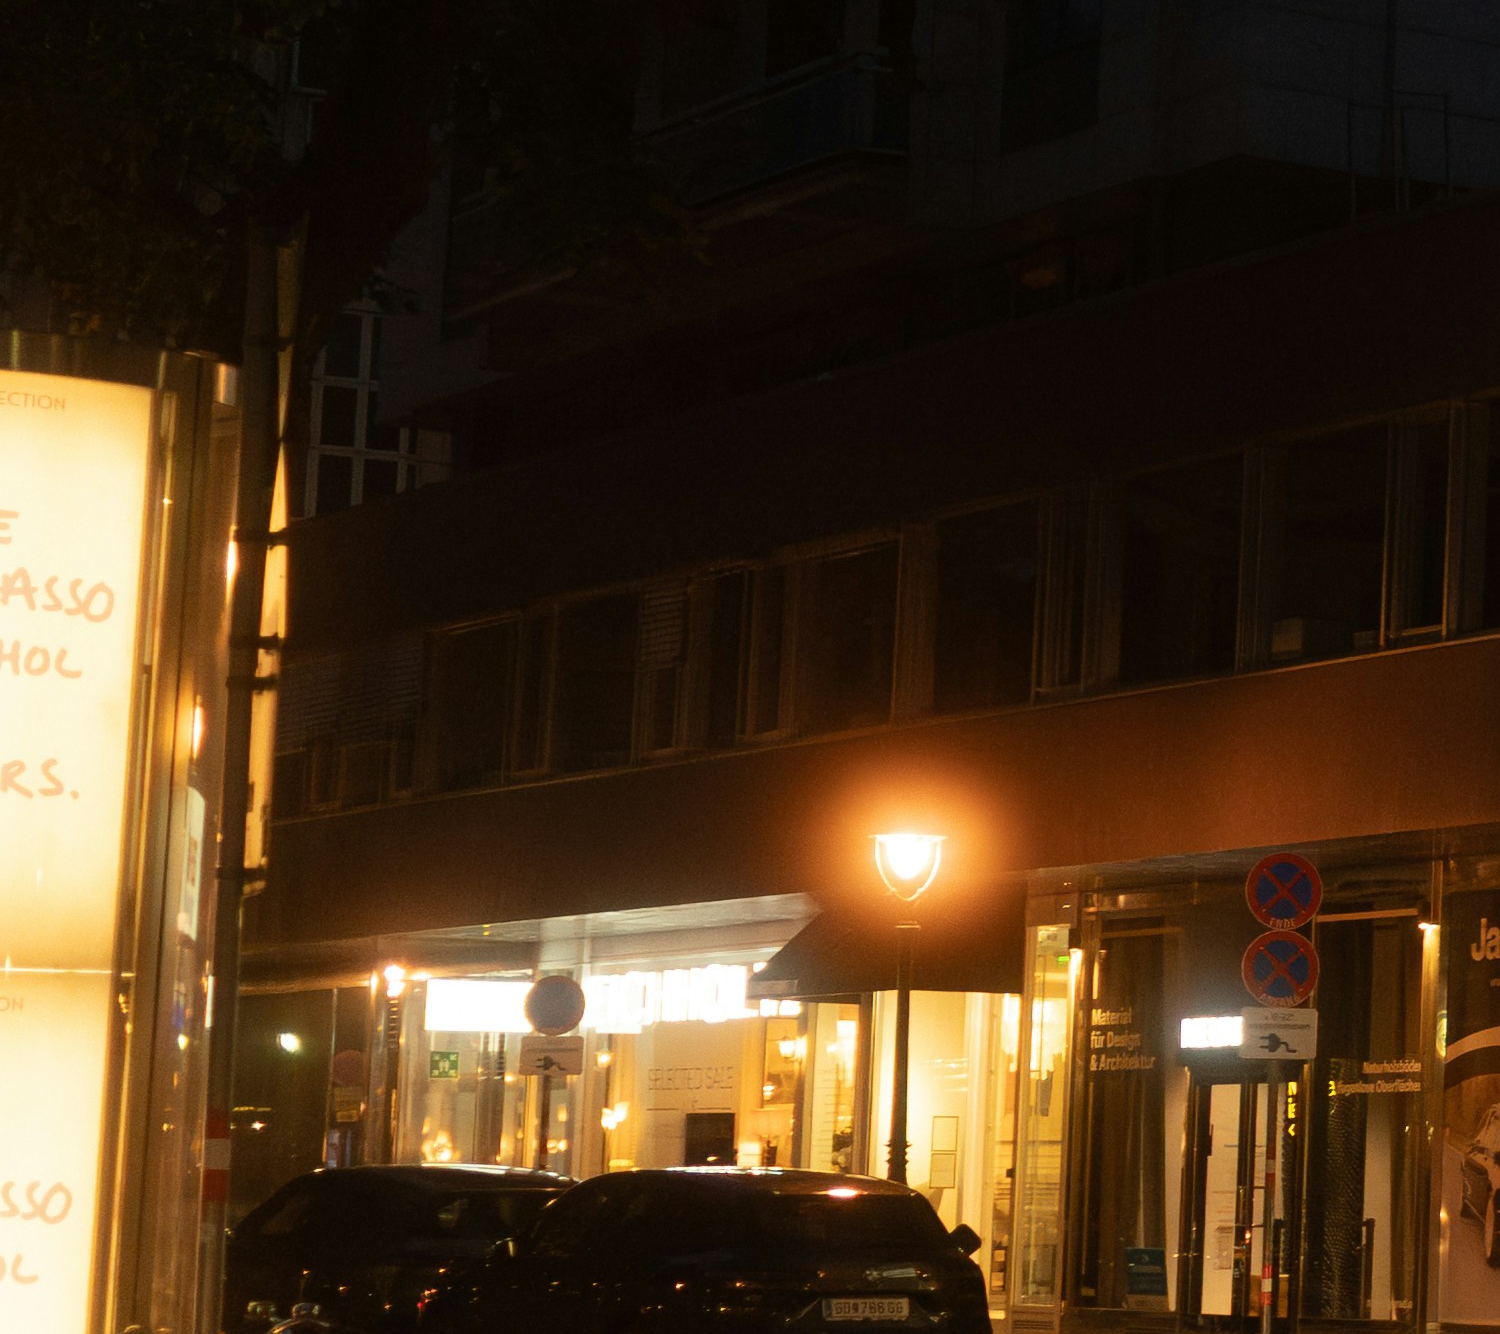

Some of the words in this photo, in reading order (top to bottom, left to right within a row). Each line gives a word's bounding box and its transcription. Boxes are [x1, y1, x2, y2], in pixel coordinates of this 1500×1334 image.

[1269, 918, 1297, 929] ENDE
[1090, 1007, 1132, 1026] Material
[1090, 1030, 1106, 1049] für
[1106, 1030, 1142, 1051] Design
